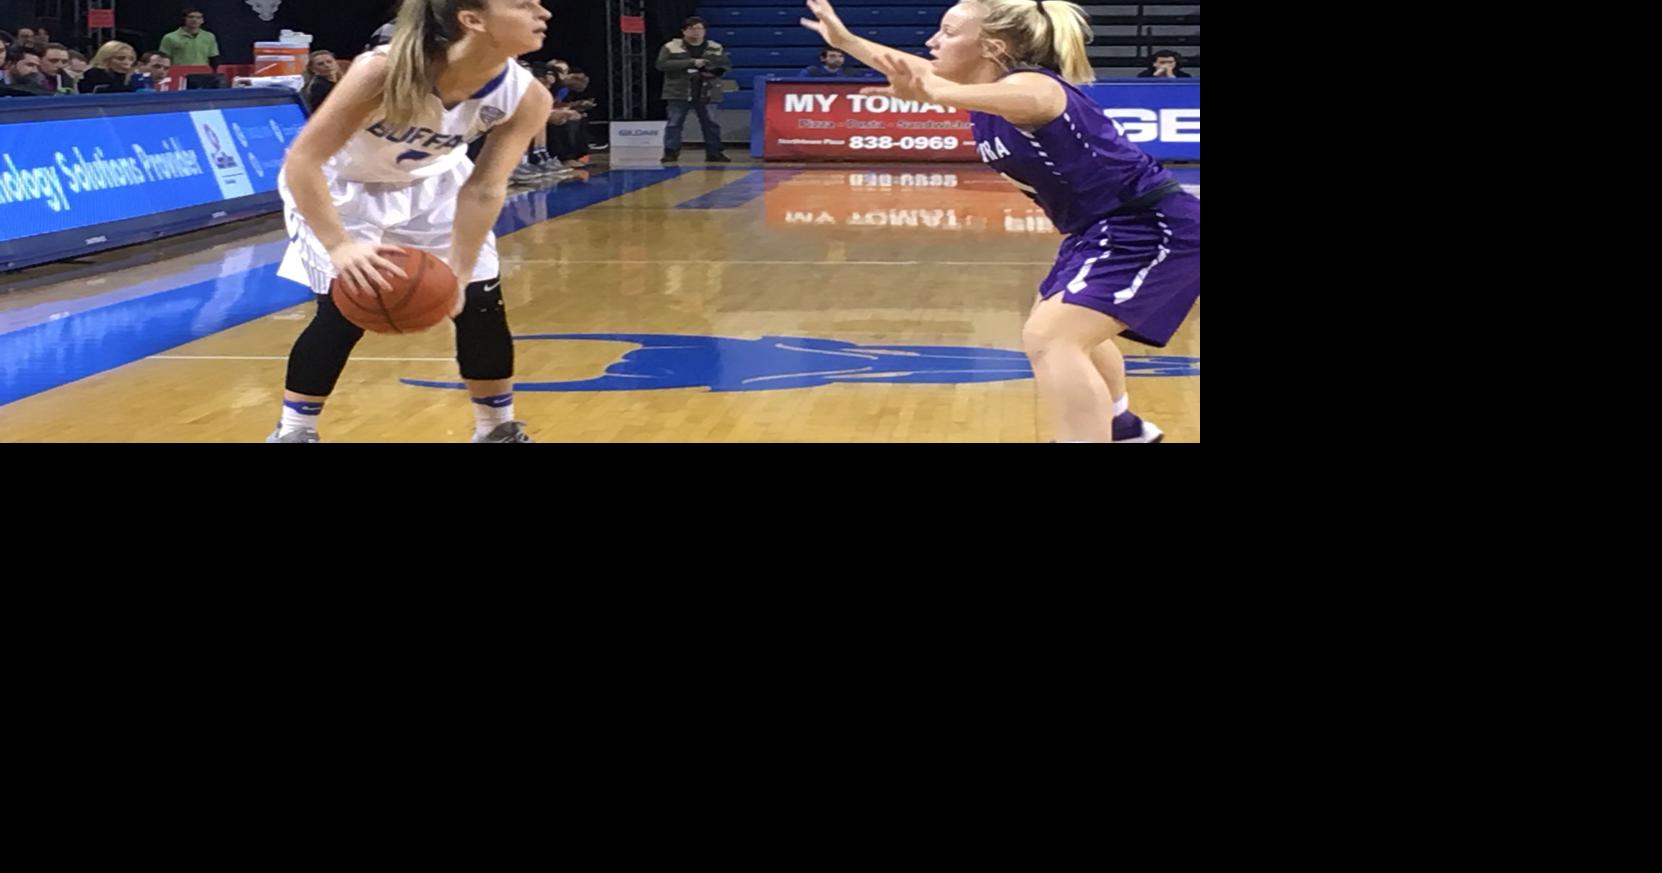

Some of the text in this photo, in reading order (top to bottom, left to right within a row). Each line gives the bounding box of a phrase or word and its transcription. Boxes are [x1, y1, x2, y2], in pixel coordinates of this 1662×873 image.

[784, 93, 957, 113] MY TOMA
[849, 136, 958, 150] 838-0969
[54, 146, 145, 193] Solutions
[131, 136, 204, 182] Provider
